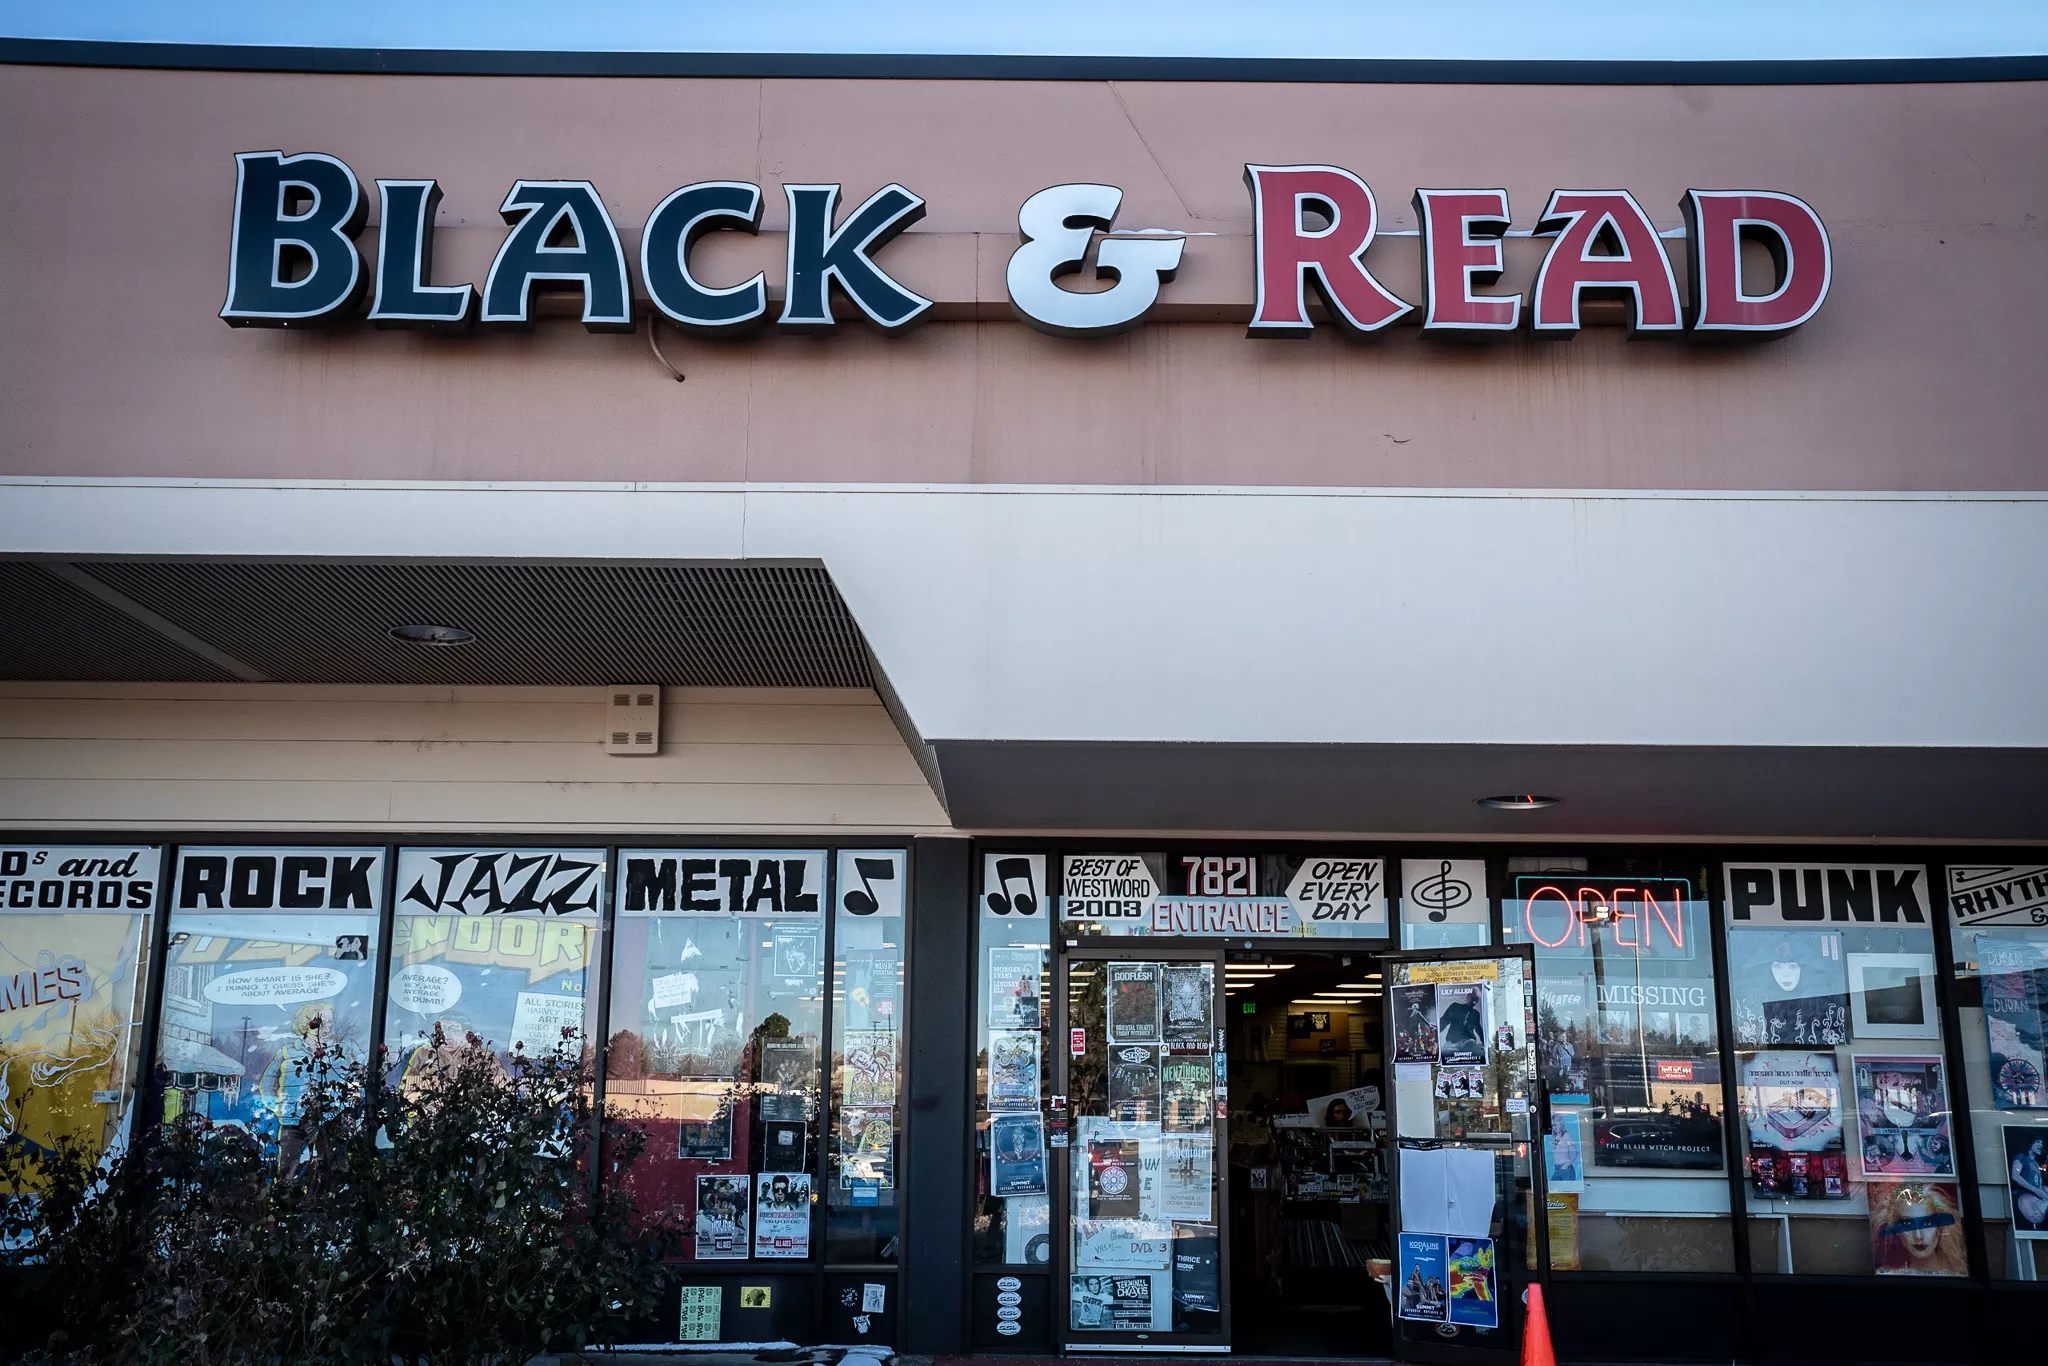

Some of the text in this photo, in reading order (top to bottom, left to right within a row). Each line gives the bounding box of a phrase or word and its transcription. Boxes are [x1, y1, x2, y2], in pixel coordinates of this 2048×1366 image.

[218, 150, 1834, 343] BLACK & READ
[57, 851, 141, 877] and
[1067, 858, 1140, 876] BEST OF
[1311, 860, 1379, 881] OPEN
[179, 856, 378, 909] ROCK
[401, 851, 598, 916] JAZZ
[1180, 856, 1257, 897] 7821
[625, 858, 818, 912] METAL
[1065, 878, 1151, 898] WESTWORD
[1298, 880, 1380, 901] EVERY
[1729, 868, 1926, 923] PUNK
[1066, 900, 1142, 917] 2003
[1311, 902, 1371, 921] DAY
[1152, 901, 1290, 933] ENTRANCE
[1526, 886, 1683, 948] OPEN
[1987, 951, 2023, 966] DURAN
[255, 975, 287, 983] SMART
[305, 972, 331, 980] SHE?
[401, 974, 449, 984] AVERAGE?
[1114, 971, 1153, 981] GODFLESH
[402, 989, 440, 997] AVERAGE
[1454, 987, 1473, 995] ALLEN
[1597, 985, 1707, 1007] MISSING
[412, 996, 445, 1005] DUMB!
[525, 998, 541, 1007] ALL
[1243, 1003, 1256, 1013] EXIT
[1994, 998, 2029, 1013] DURAN
[527, 1007, 560, 1016] HARVEY
[1170, 1042, 1209, 1050] BLACK AND READ
[1162, 1064, 1210, 1082] MENZINGERS
[1623, 1143, 1646, 1151] BLAIR
[1677, 1145, 1711, 1153] PROJECT
[1131, 1242, 1153, 1254] DVDs
[1409, 1241, 1440, 1252] KODALINE
[1176, 1254, 1201, 1264] THRICE
[1116, 1279, 1149, 1290] TERMINAL
[1117, 1287, 1149, 1298] CHAOS
